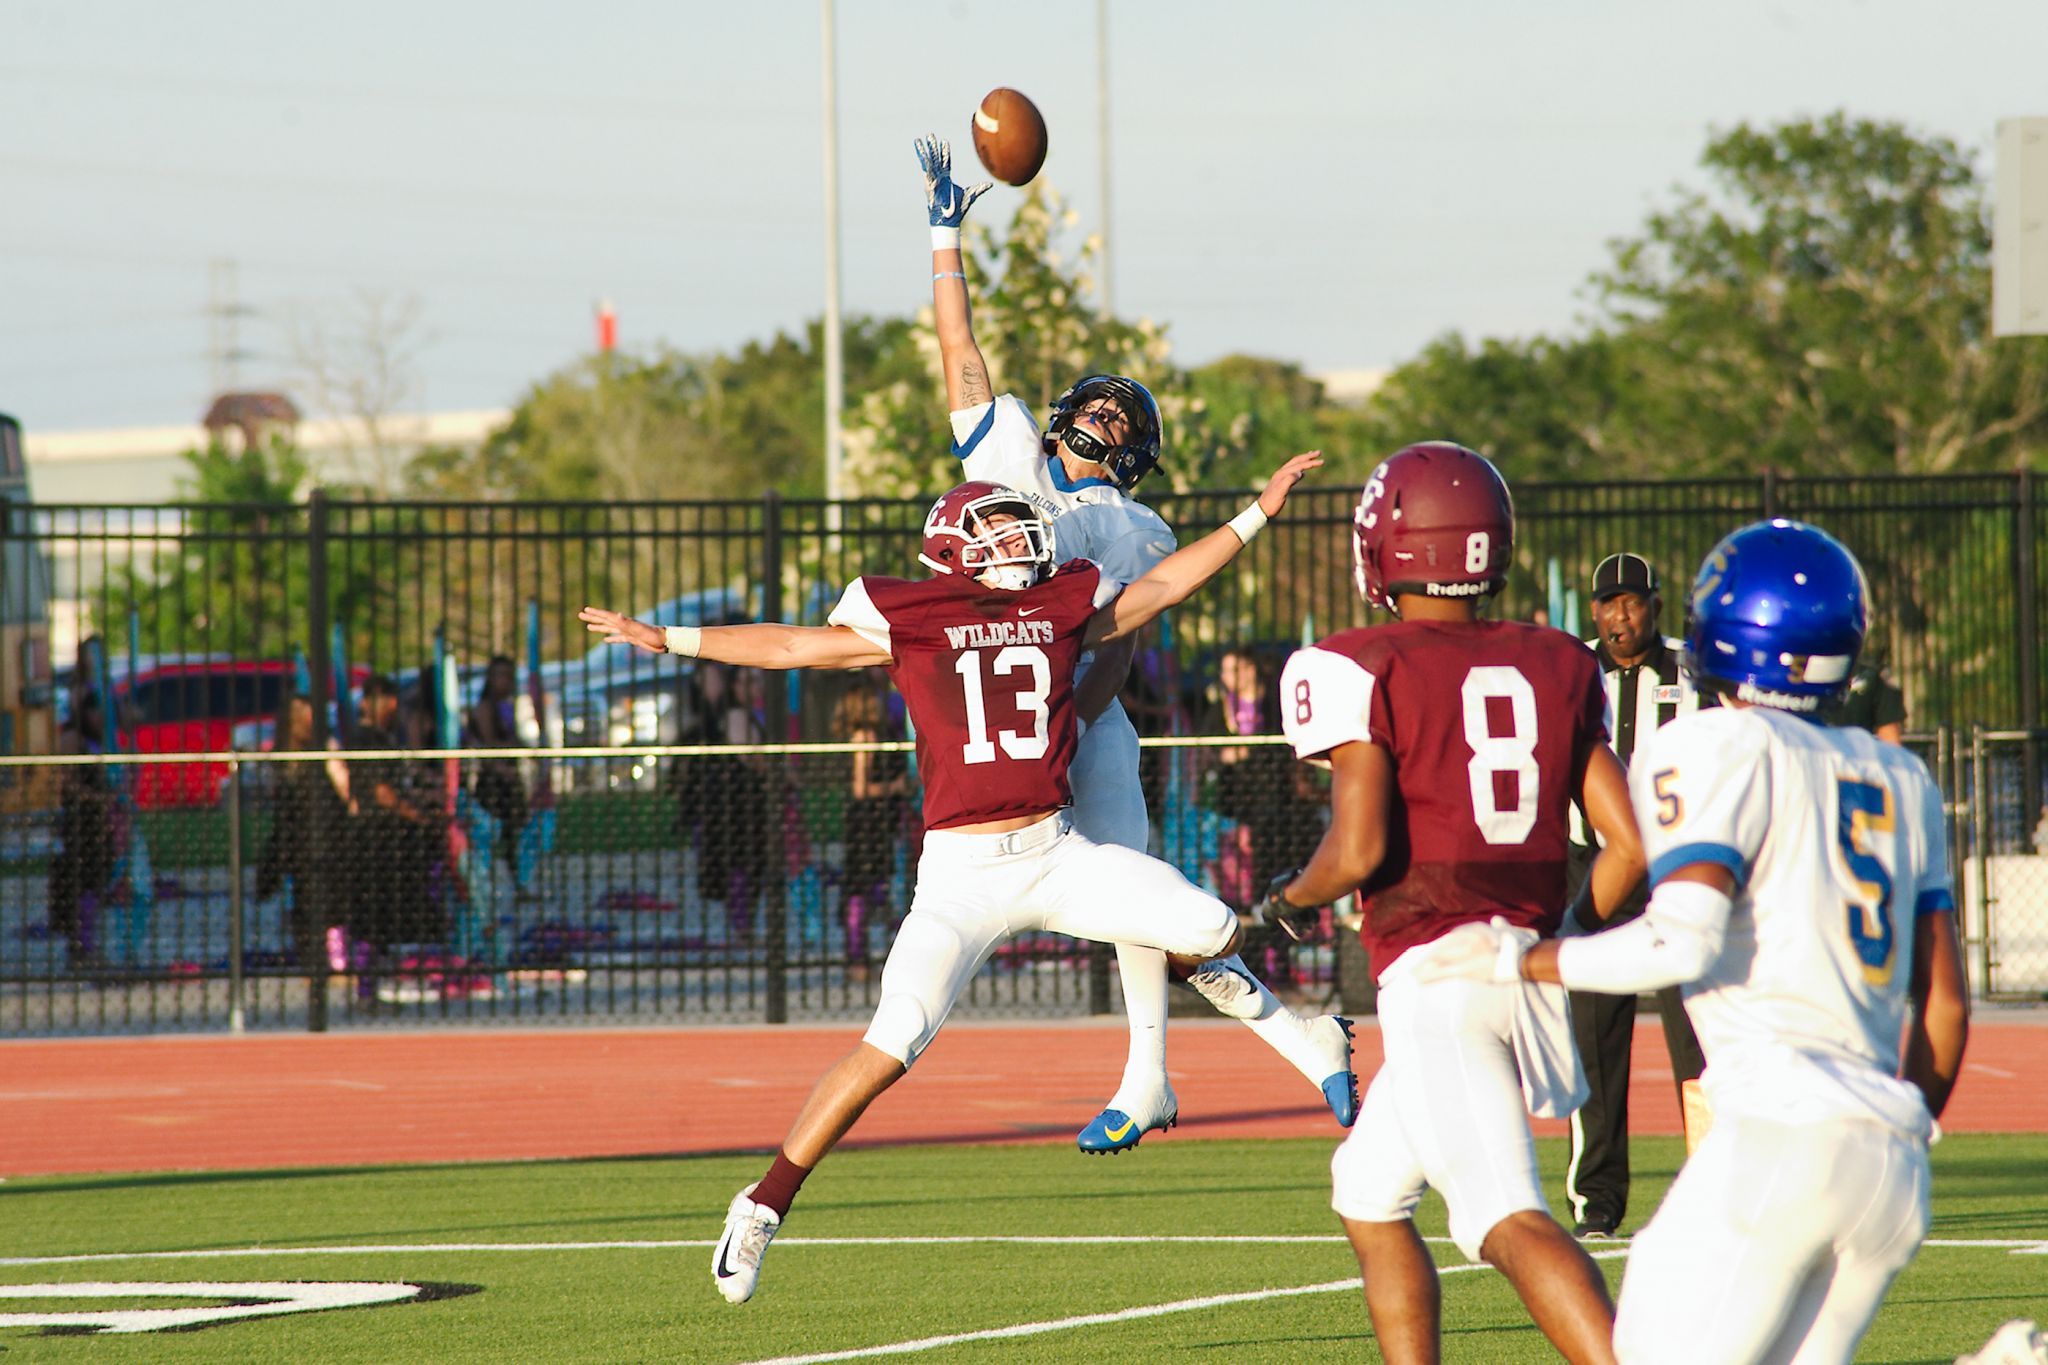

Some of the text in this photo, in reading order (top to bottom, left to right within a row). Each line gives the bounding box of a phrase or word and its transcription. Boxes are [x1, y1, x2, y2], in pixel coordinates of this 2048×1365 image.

[1031, 492, 1062, 517] FALCONS
[1465, 532, 1489, 574] 8
[1427, 581, 1490, 597] Riddell
[944, 620, 1054, 649] WILDCATS
[955, 646, 1051, 764] 13
[1296, 679, 1312, 726] 8
[1461, 665, 1540, 845] 8
[1652, 766, 1685, 832] 5
[1837, 774, 1895, 987] 5
